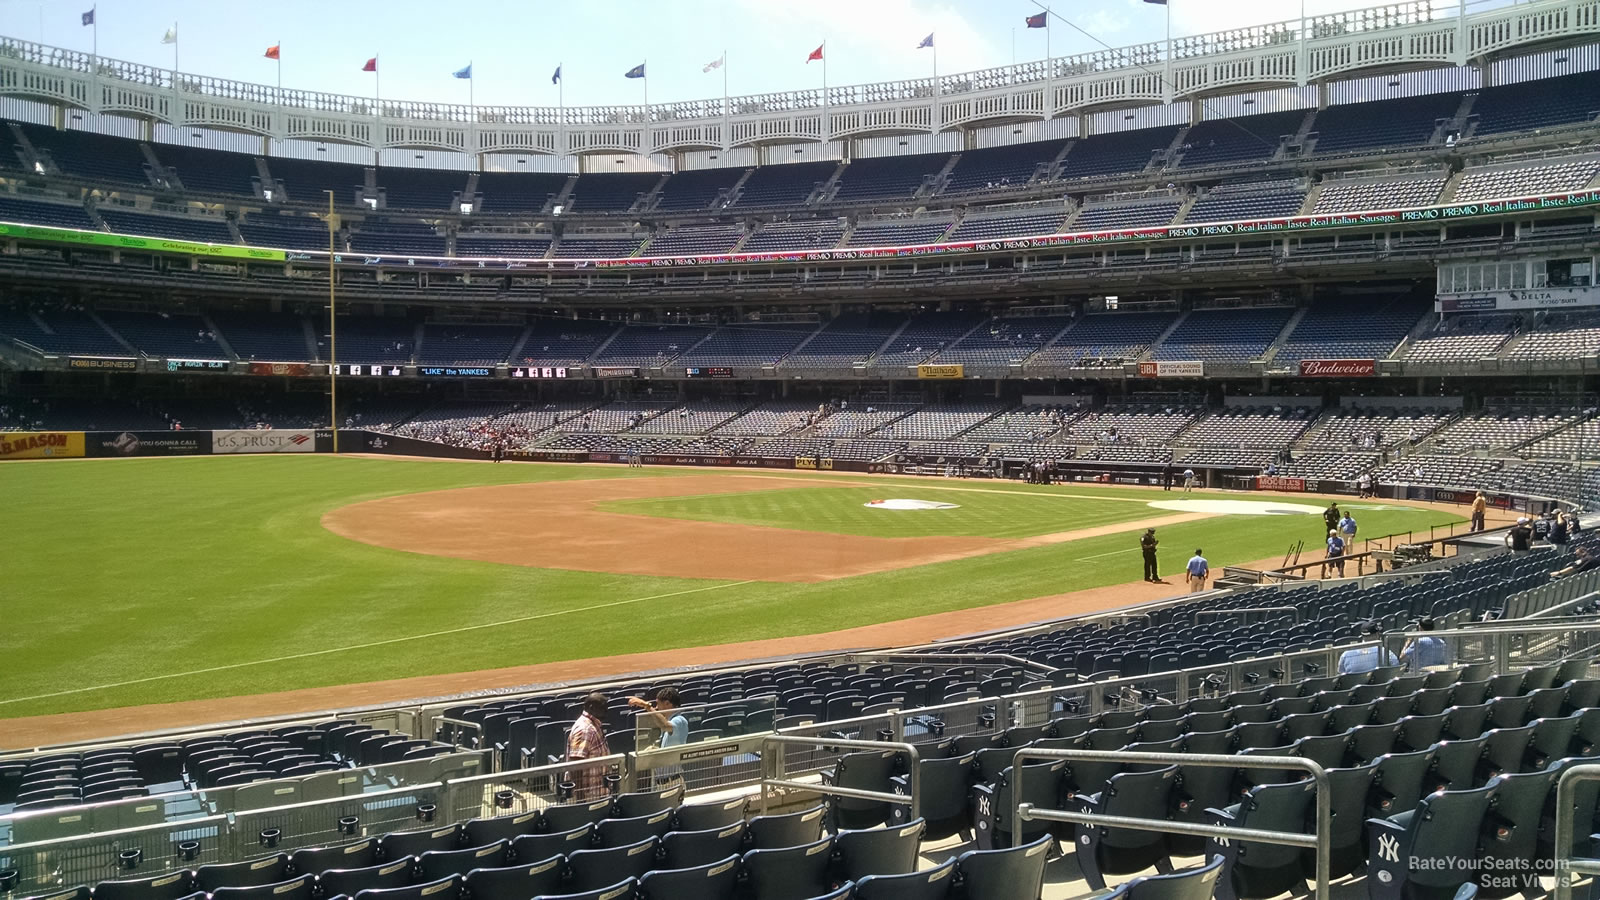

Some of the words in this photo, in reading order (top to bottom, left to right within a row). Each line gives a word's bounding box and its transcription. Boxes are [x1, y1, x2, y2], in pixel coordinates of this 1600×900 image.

[1482, 203, 1500, 213] Real
[1505, 201, 1535, 211] Italian
[1568, 193, 1588, 204] Real
[1402, 209, 1438, 220] PREMIO
[1442, 205, 1478, 217] PREMIO
[1237, 222, 1255, 232] Real
[1257, 221, 1283, 230] Italian
[1310, 217, 1329, 227] Real
[1331, 215, 1357, 225] Italian
[1169, 227, 1199, 237] PREMIO
[1202, 225, 1233, 235] PREMIO
[1032, 239, 1047, 247] Real
[1049, 237, 1070, 246] Italian
[1092, 234, 1109, 242] Real
[1110, 232, 1132, 241] Italian
[162, 242, 197, 252] Celebrating
[975, 242, 1001, 251] PREMIO
[1003, 240, 1030, 249] PREMIO
[806, 252, 831, 261] PREMIO
[832, 251, 857, 260] PREMIO
[859, 250, 873, 258] Real
[874, 250, 894, 258] Italian
[927, 246, 946, 255] Italian
[595, 260, 609, 268] Real
[651, 259, 673, 267] PREMIO
[674, 258, 697, 266] PREMIO
[698, 257, 711, 265] Real
[711, 256, 729, 264] Italian
[746, 255, 760, 263] Real
[760, 254, 779, 262] Italian
[1521, 292, 1551, 300] DELTA
[90, 360, 136, 368] BUSINESS
[1140, 364, 1156, 374] JBL
[1301, 361, 1373, 374] Budweiser
[14, 433, 67, 451] MASON
[217, 437, 239, 447] U.S.
[244, 435, 285, 447] TRUST
[1260, 477, 1300, 486] MODELL'S
[1536, 525, 1547, 533] 25
[979, 795, 990, 816] NY
[1377, 832, 1400, 862] NY
